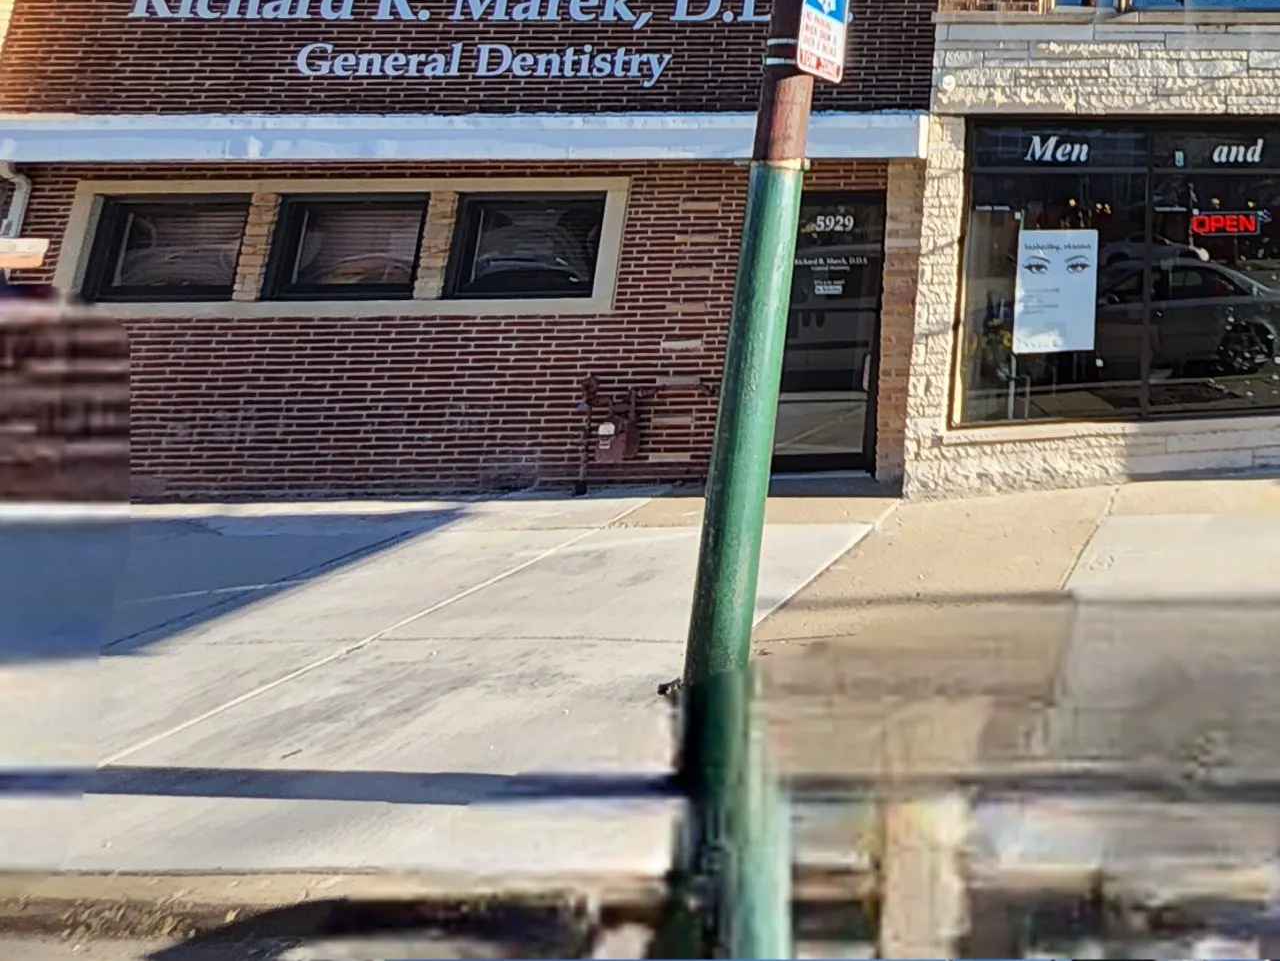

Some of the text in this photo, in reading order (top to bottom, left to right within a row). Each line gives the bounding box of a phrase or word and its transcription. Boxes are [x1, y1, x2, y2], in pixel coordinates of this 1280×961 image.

[296, 42, 673, 88] General Dentistry
[1024, 134, 1090, 163] Men
[1212, 138, 1264, 164] and
[814, 215, 855, 232] 5929
[1191, 213, 1257, 234] OPEN
